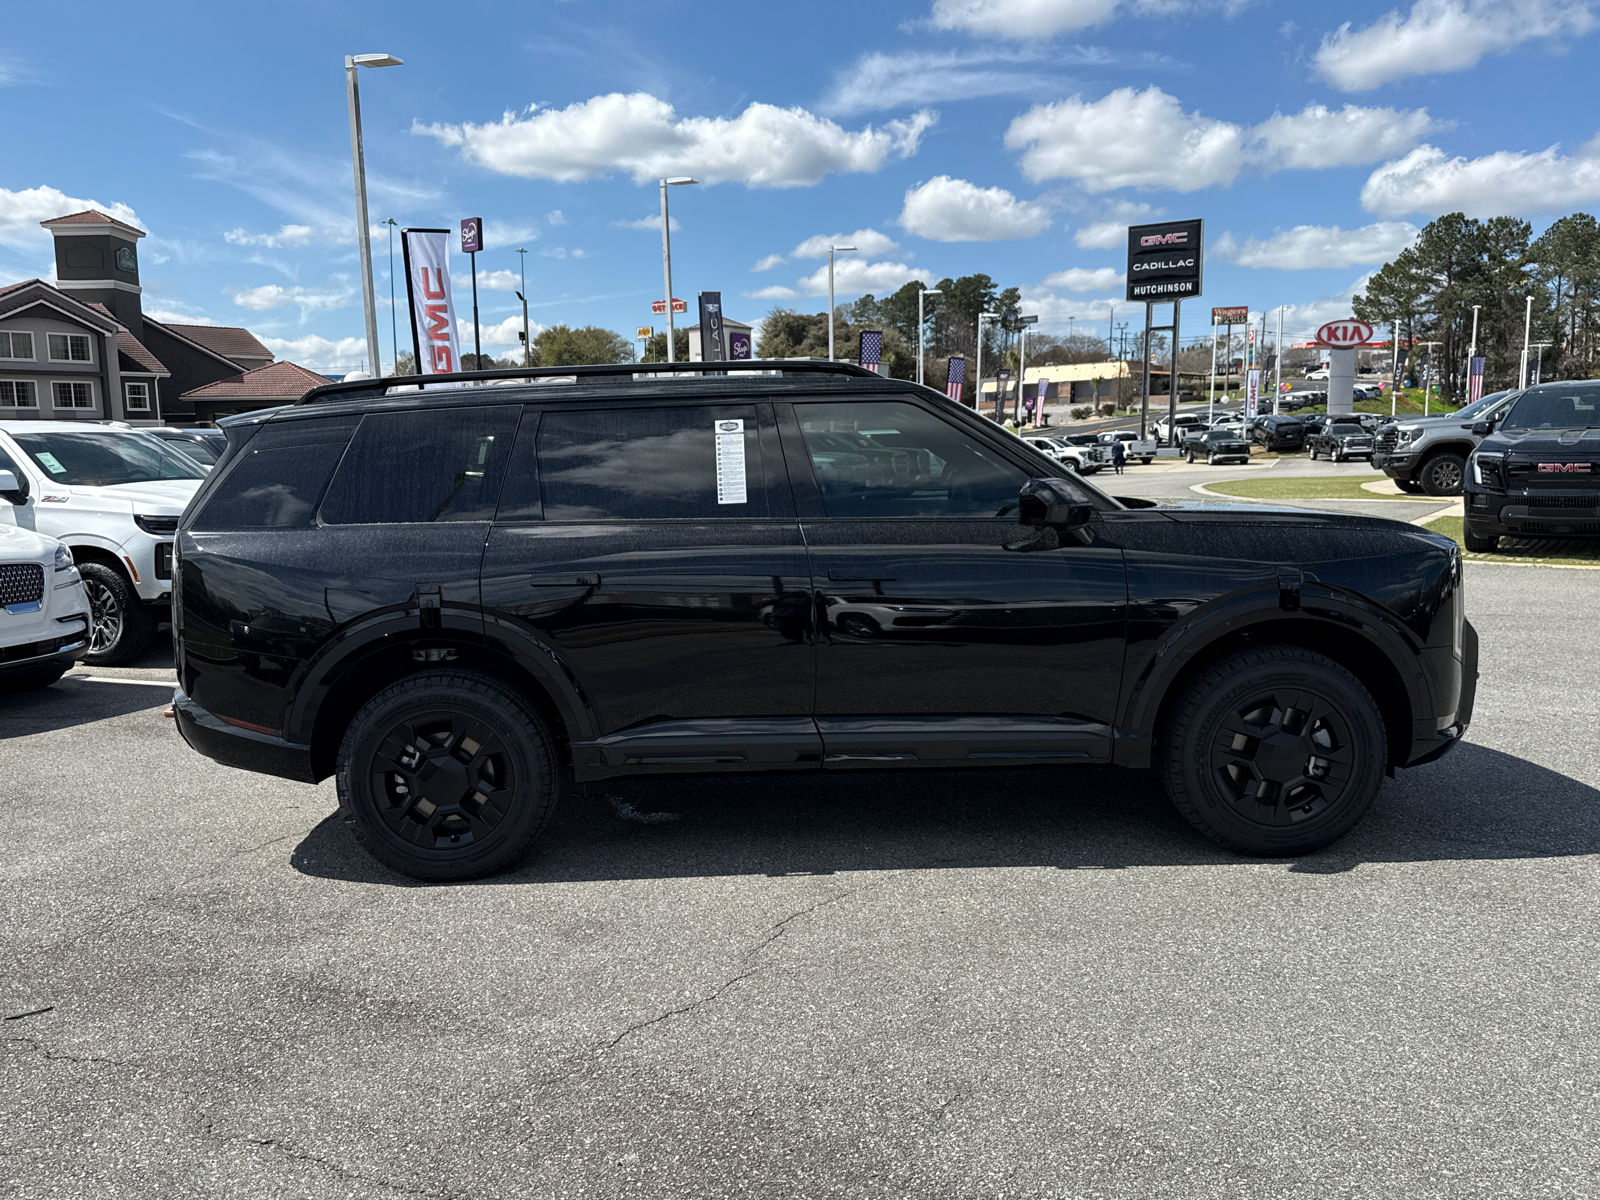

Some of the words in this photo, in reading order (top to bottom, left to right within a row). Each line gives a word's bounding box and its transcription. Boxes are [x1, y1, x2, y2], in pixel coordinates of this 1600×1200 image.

[1140, 232, 1188, 246] GMC
[1133, 259, 1194, 271] CADILLAC
[1134, 282, 1192, 295] HUTCHINSON
[421, 267, 453, 374] GMC
[1327, 326, 1363, 341] KIA
[1538, 463, 1591, 472] GMC
